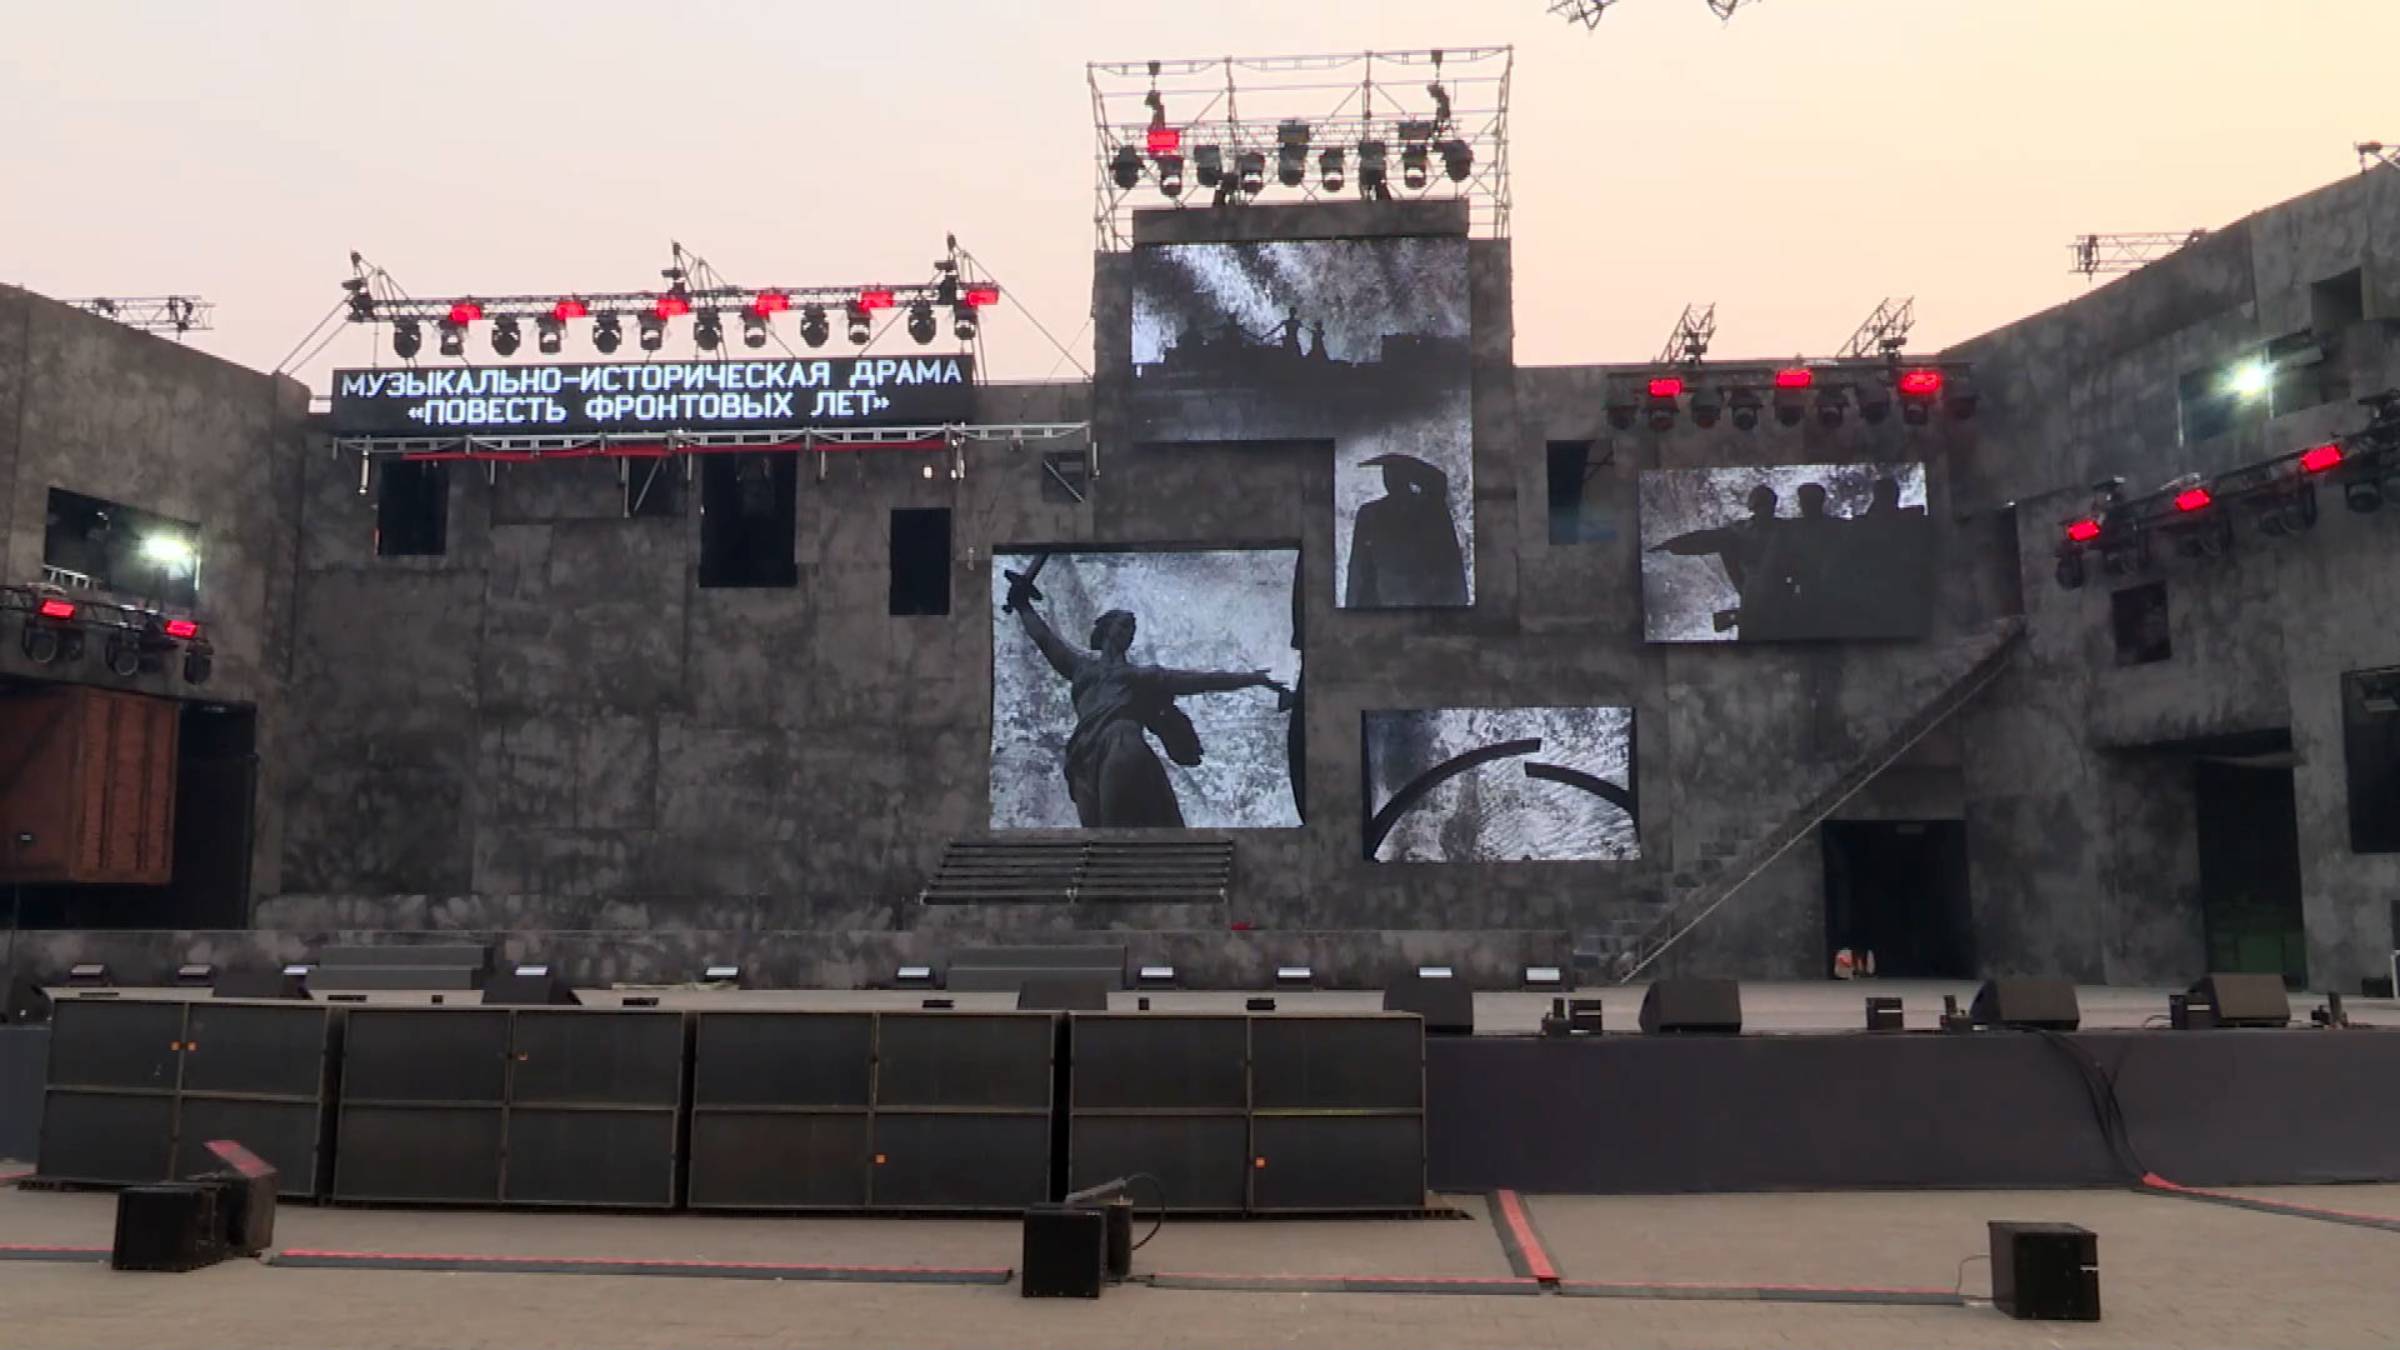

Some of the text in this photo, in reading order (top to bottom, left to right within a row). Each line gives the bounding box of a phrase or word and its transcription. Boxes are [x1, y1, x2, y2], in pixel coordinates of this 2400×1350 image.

[341, 359, 962, 397] МУЗЫКАЛЬНО-ИСТОРИЧЕСКАЯ ДРАМА
[408, 389, 890, 425] «ПОВЕСТЬ ФРОНТОВЫХ ЛЕТ»
